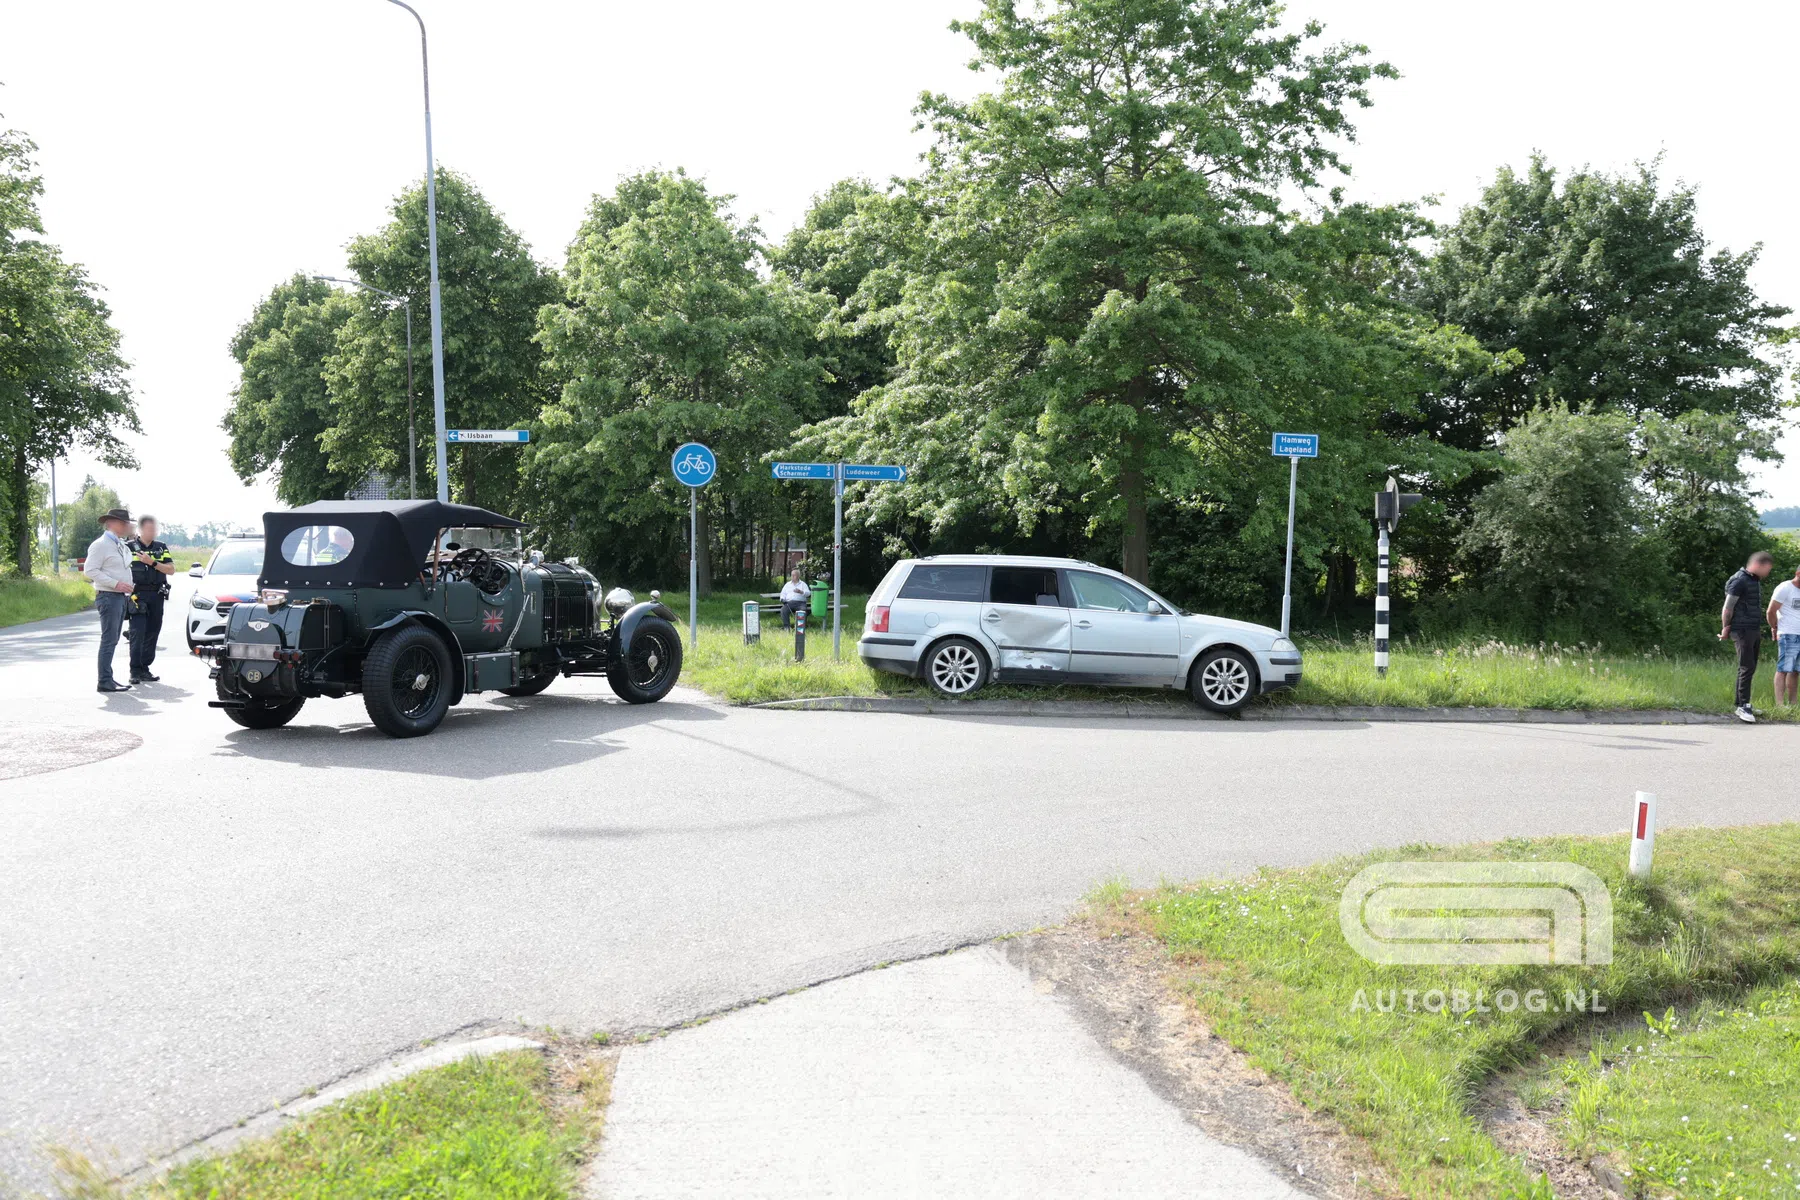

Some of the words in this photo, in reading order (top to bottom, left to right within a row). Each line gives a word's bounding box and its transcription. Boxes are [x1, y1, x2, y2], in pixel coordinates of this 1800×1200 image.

[1281, 436, 1311, 446] Hamweg
[1279, 445, 1312, 455] Lageland
[247, 671, 260, 681] GB
